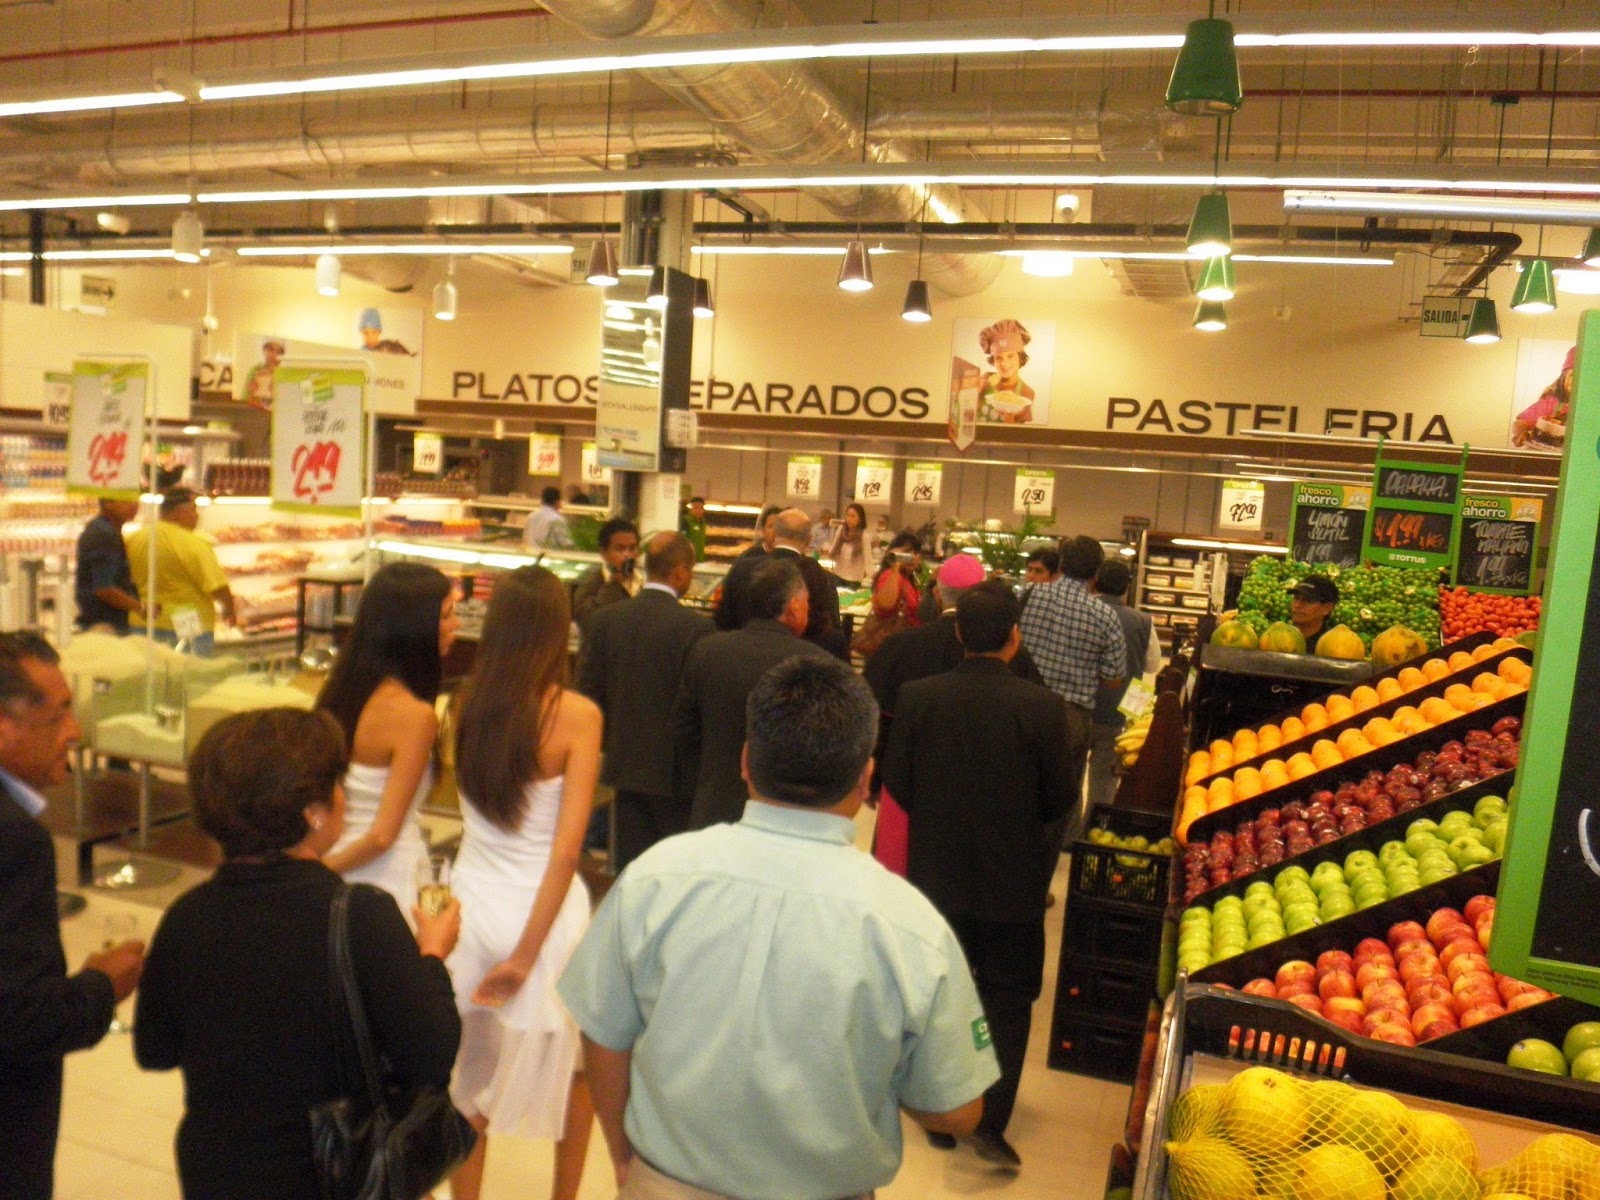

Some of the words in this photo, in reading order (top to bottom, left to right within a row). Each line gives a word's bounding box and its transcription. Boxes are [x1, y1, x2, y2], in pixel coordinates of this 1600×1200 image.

[1423, 309, 1458, 323] SALIDA
[452, 371, 597, 404] PLATOS
[690, 380, 930, 419] EPARADOS
[1105, 397, 1455, 445] PASTELERIA
[1024, 469, 1047, 477] OFERTA
[1300, 485, 1332, 496] fresco
[1297, 493, 1340, 506] ahorro
[1465, 497, 1499, 508] fresco
[1462, 506, 1507, 518] ahorro
[1396, 554, 1426, 564] TOTTUS
